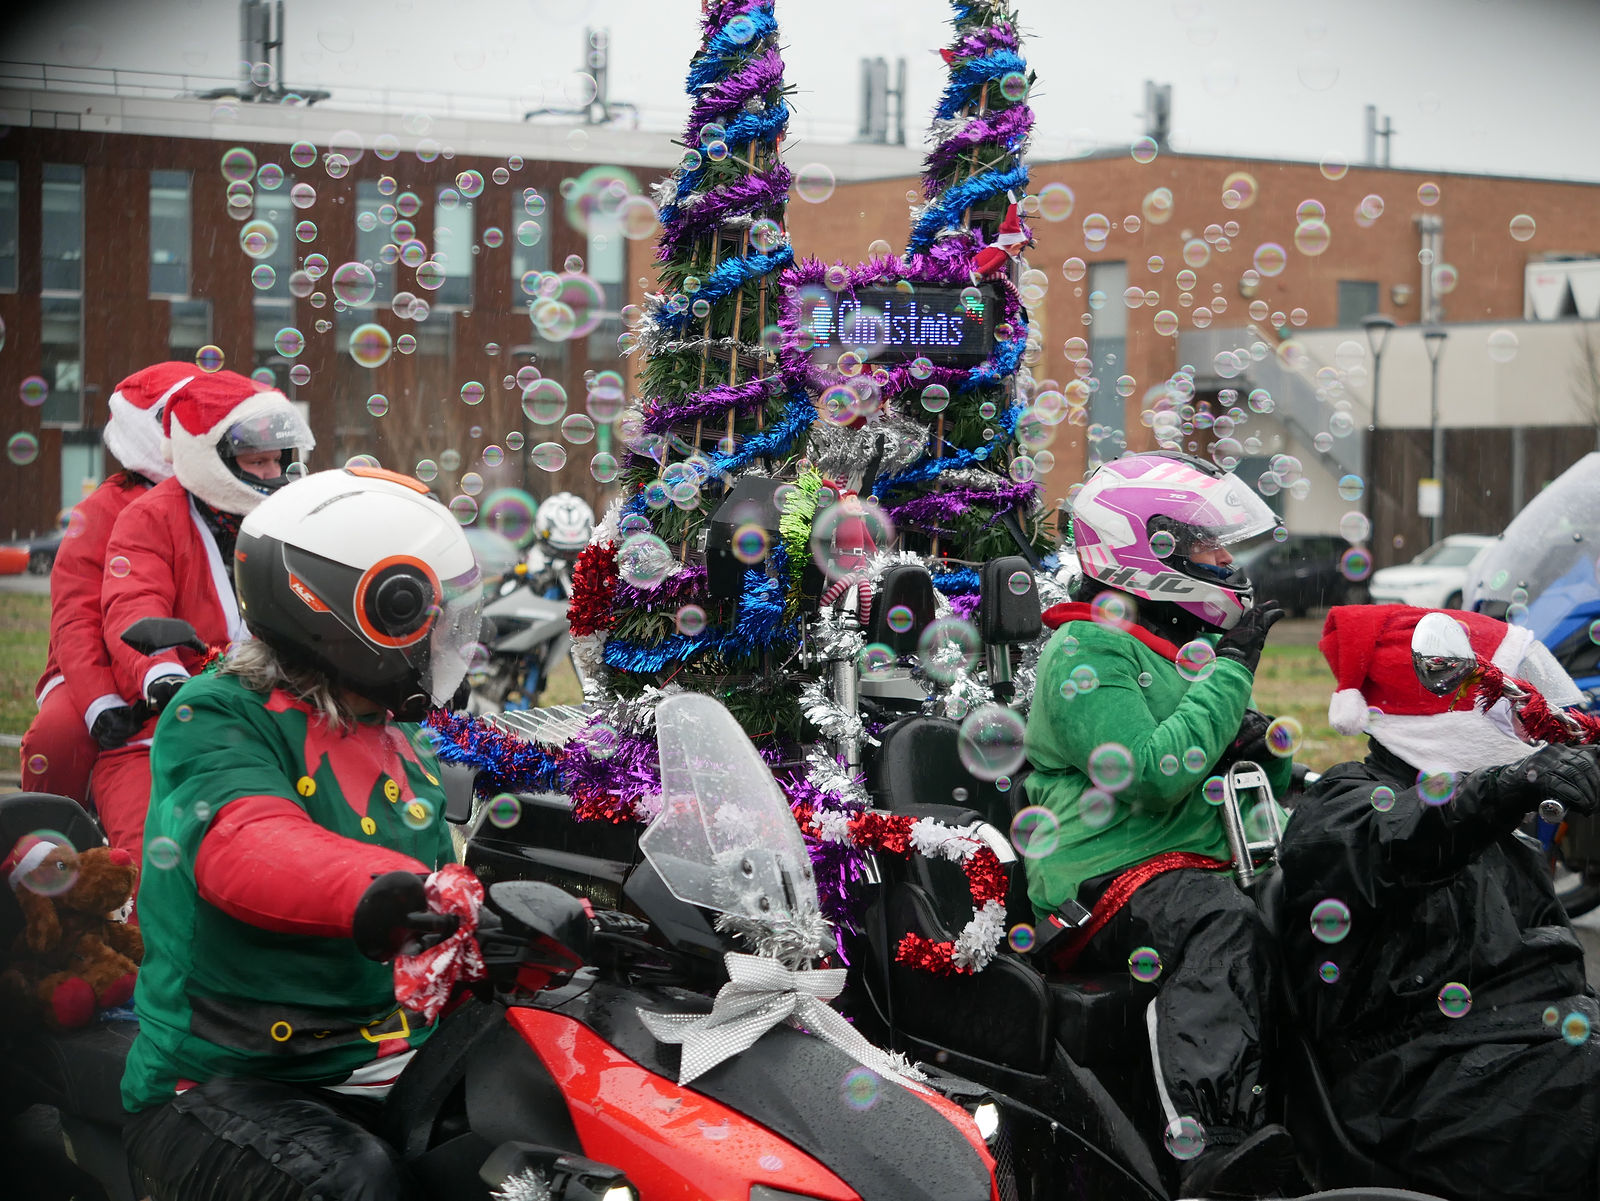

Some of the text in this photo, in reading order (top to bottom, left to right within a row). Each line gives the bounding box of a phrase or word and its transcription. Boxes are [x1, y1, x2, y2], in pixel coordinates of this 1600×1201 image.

[838, 300, 963, 345] Christmas
[292, 583, 315, 603] HJC
[1097, 566, 1195, 594] HJC
